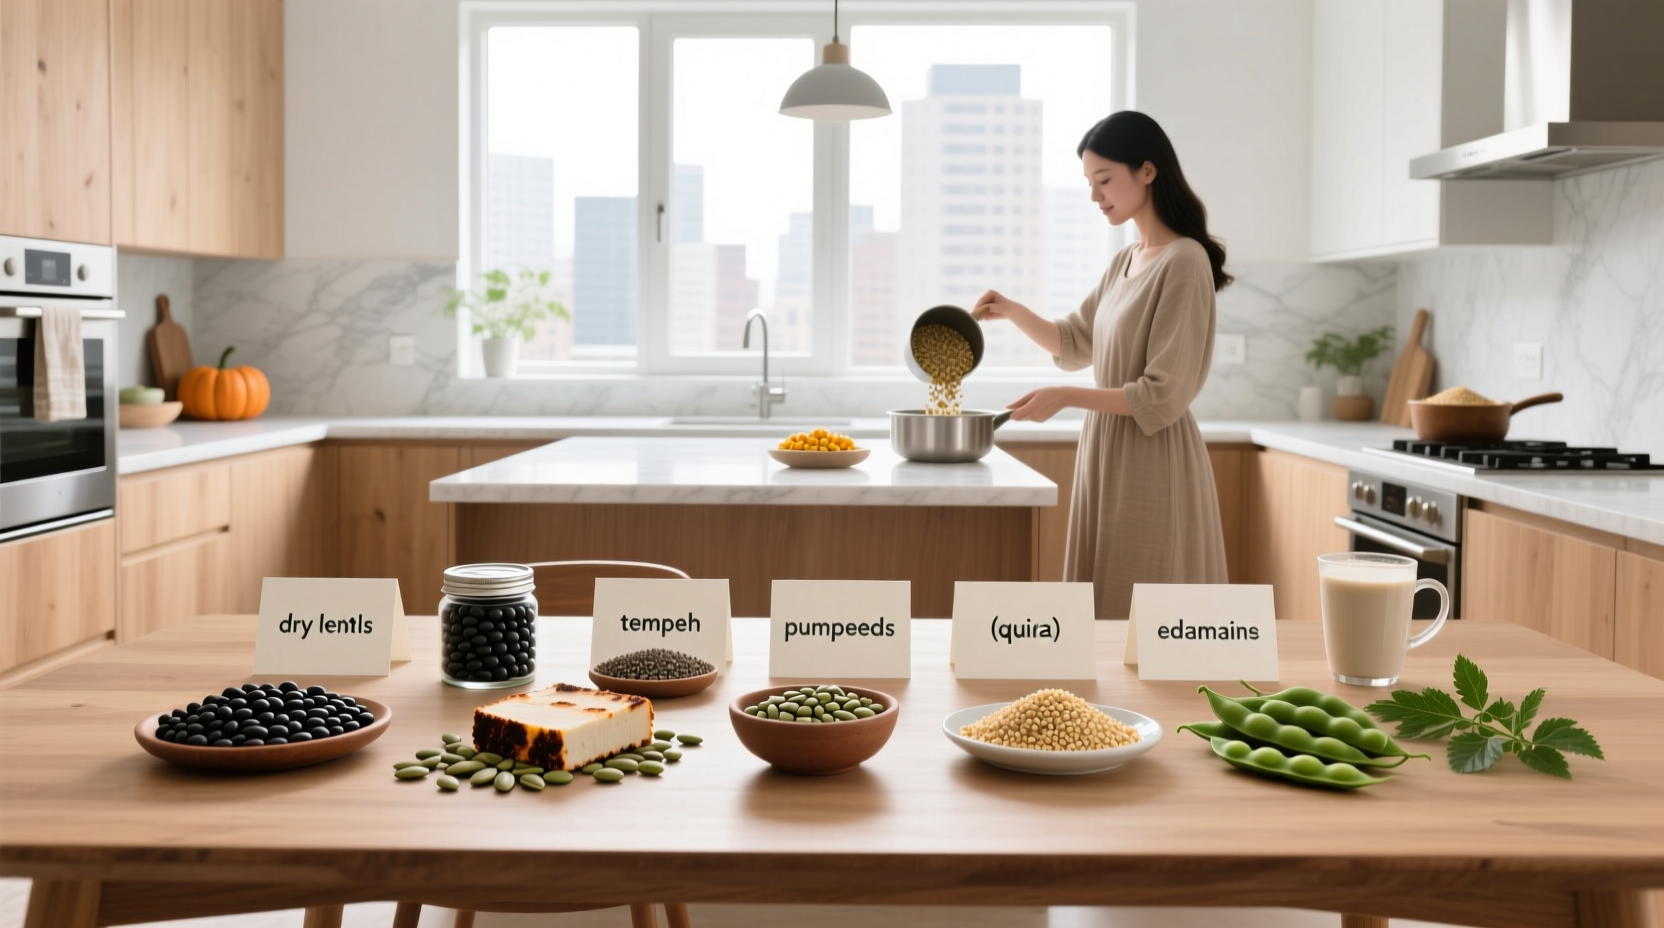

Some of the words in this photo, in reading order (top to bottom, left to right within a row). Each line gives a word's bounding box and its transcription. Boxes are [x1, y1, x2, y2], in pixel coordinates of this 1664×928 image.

[278, 612, 314, 640] dry
[620, 611, 701, 637] tempeh
[784, 616, 895, 642] pumpeeds
[991, 615, 1061, 644] (quira)
[1157, 618, 1260, 640] edamains
